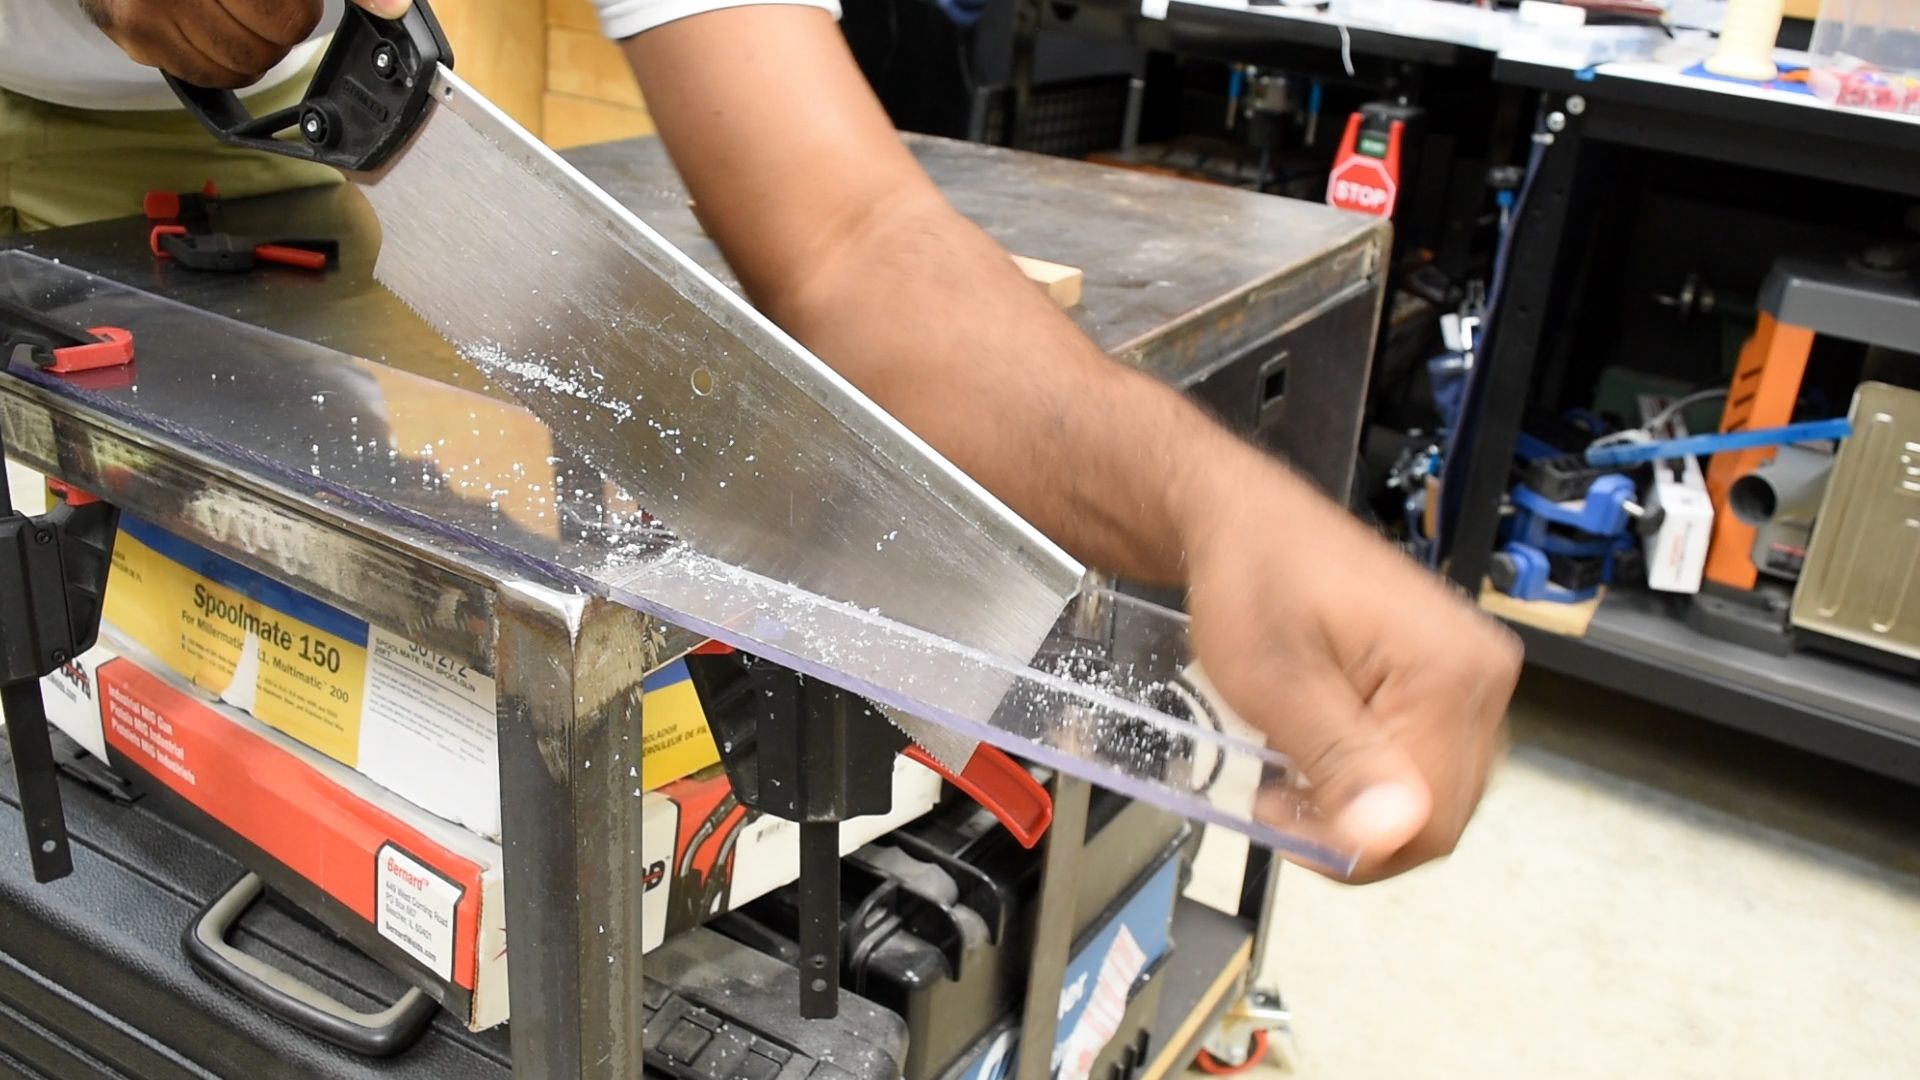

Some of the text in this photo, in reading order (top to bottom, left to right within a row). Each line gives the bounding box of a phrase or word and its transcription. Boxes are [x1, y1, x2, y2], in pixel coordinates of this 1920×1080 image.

[1335, 180, 1388, 208] STOP
[181, 610, 195, 625] For
[329, 684, 349, 704] 200
[193, 583, 293, 651] Spoolmate
[298, 634, 340, 674] 150
